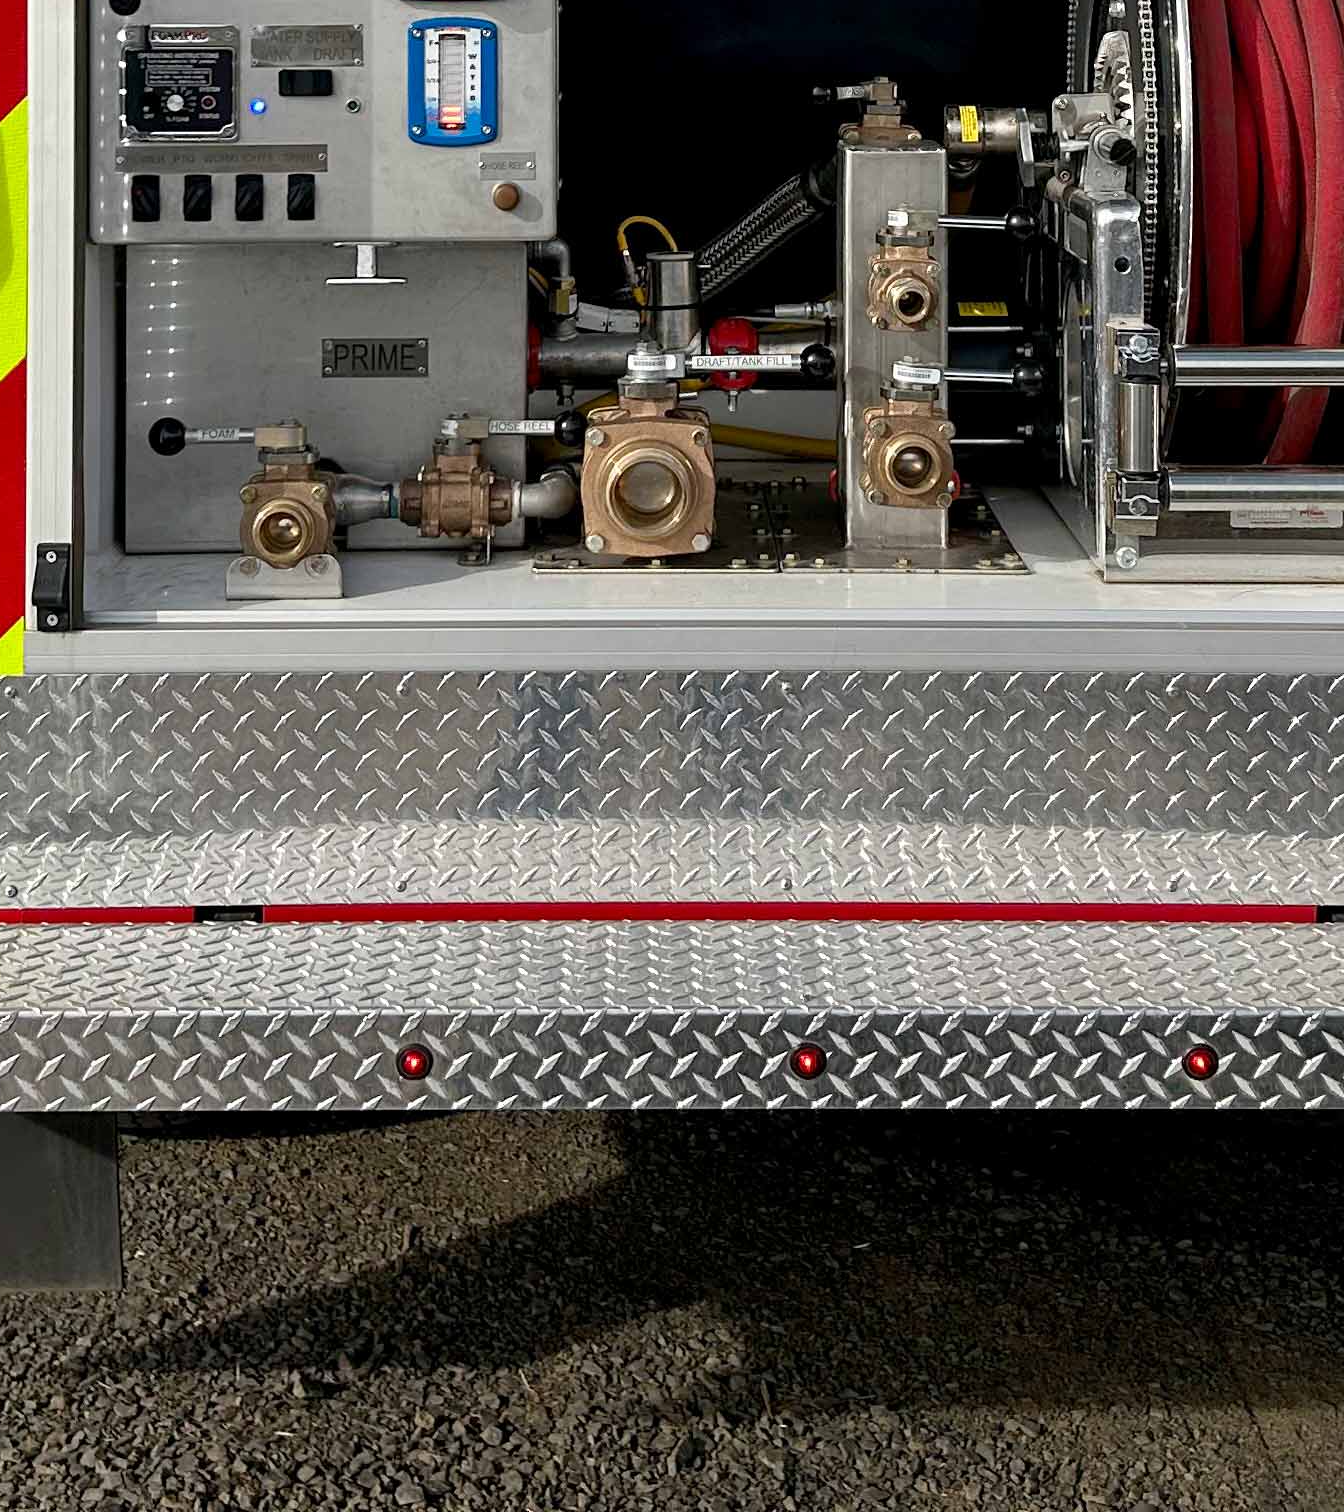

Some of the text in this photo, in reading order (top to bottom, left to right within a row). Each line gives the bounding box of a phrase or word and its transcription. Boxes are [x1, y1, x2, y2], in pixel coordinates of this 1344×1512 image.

[334, 344, 416, 370] PRIME
[490, 421, 521, 432] HOSE
[202, 429, 236, 439] FOAM
